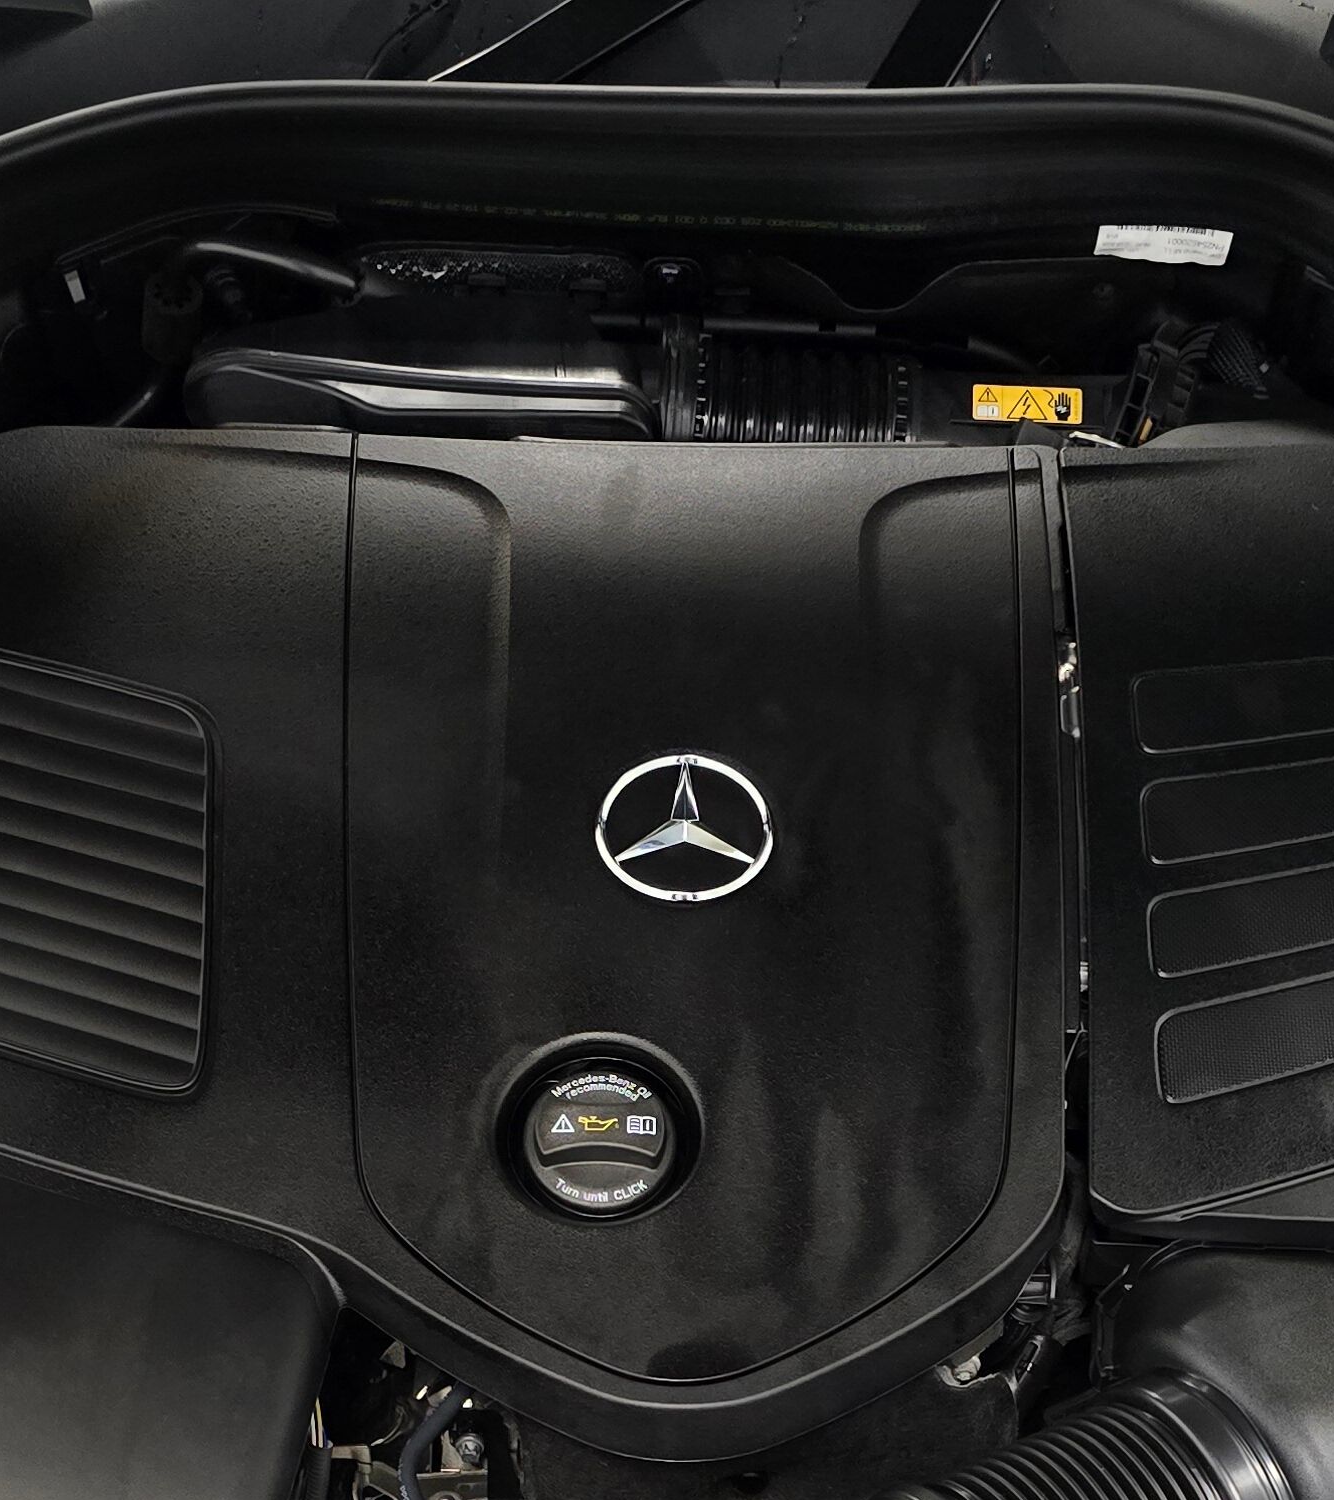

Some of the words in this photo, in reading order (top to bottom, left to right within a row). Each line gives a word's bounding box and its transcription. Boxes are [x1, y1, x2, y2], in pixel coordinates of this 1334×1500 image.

[550, 1074, 637, 1098] Mercedes-Benz
[636, 1086, 653, 1099] Oil
[565, 1082, 640, 1102] recommended
[555, 1177, 580, 1198] Turn
[582, 1191, 609, 1202] until
[613, 1179, 648, 1201] CLICK
